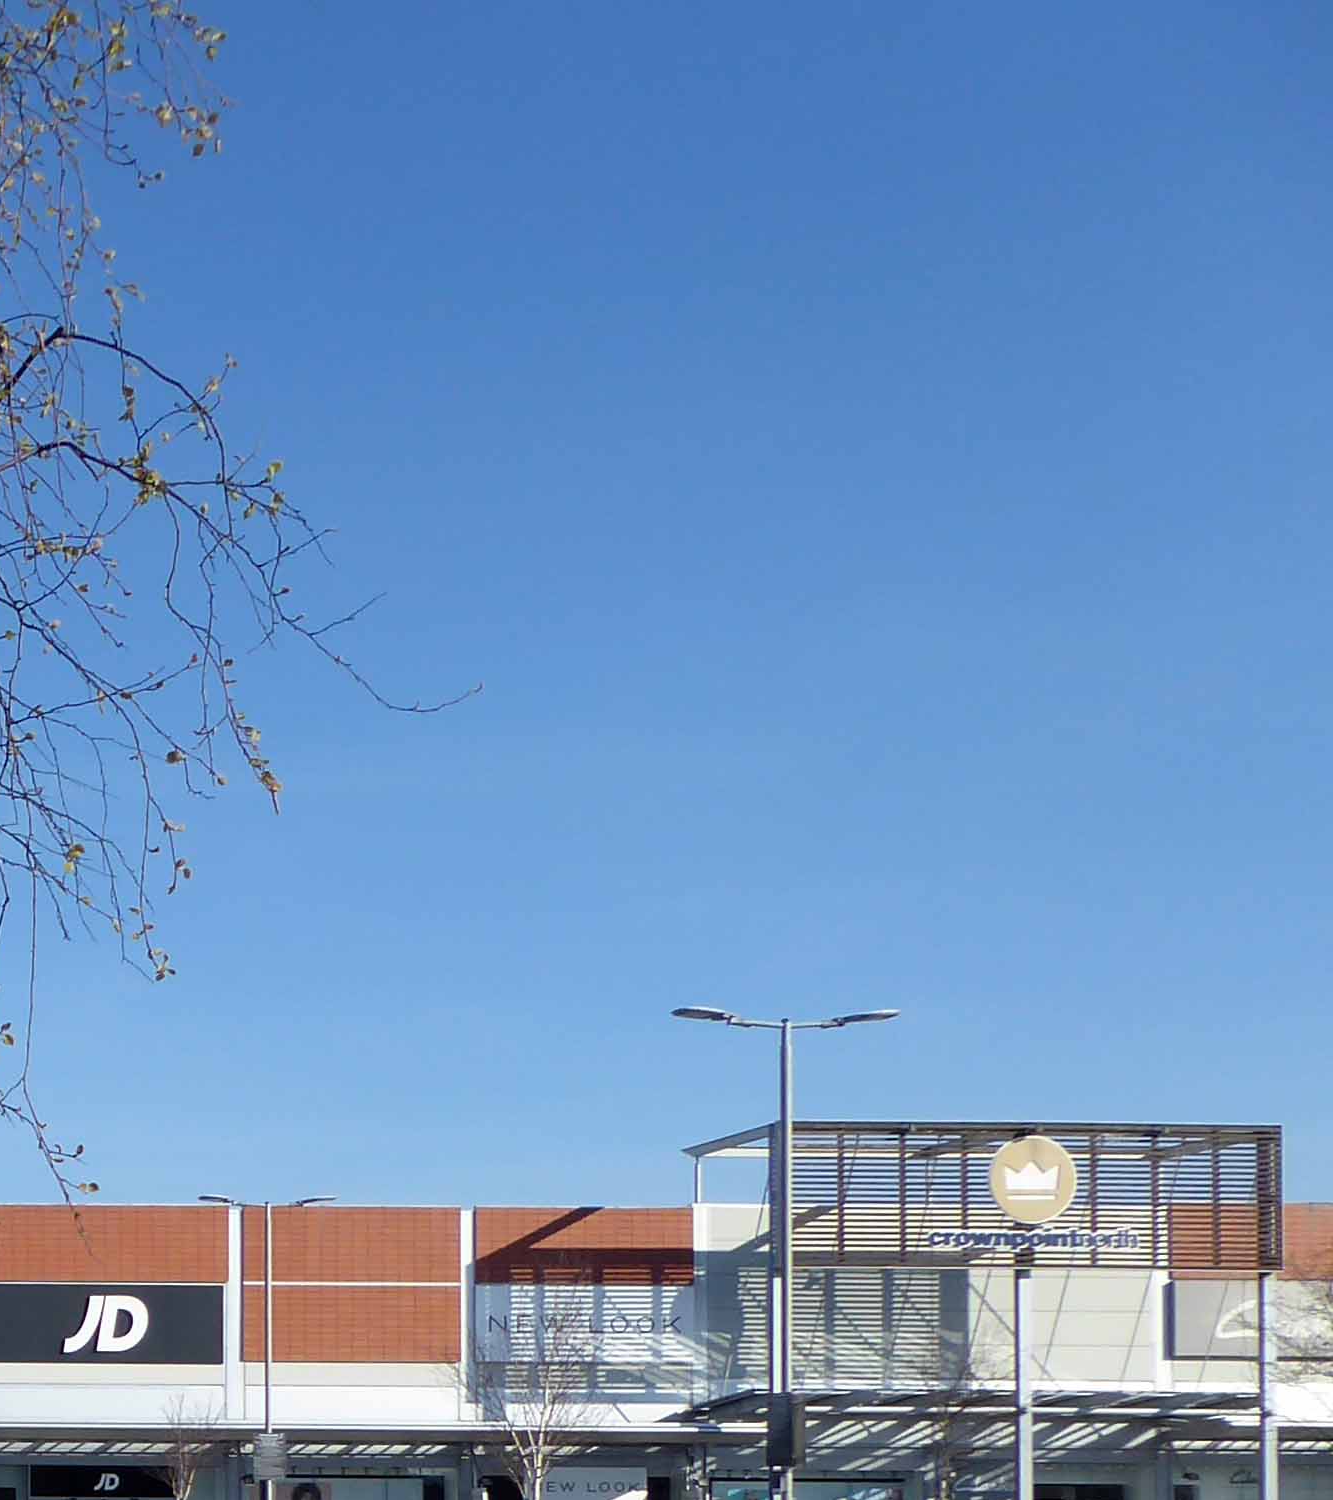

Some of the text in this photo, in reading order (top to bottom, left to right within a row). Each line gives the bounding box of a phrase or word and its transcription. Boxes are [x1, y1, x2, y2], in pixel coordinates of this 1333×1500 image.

[63, 1295, 149, 1353] JD
[589, 1315, 682, 1333] LOOK
[93, 1473, 120, 1491] JD
[538, 1481, 641, 1493] EW LOOK
